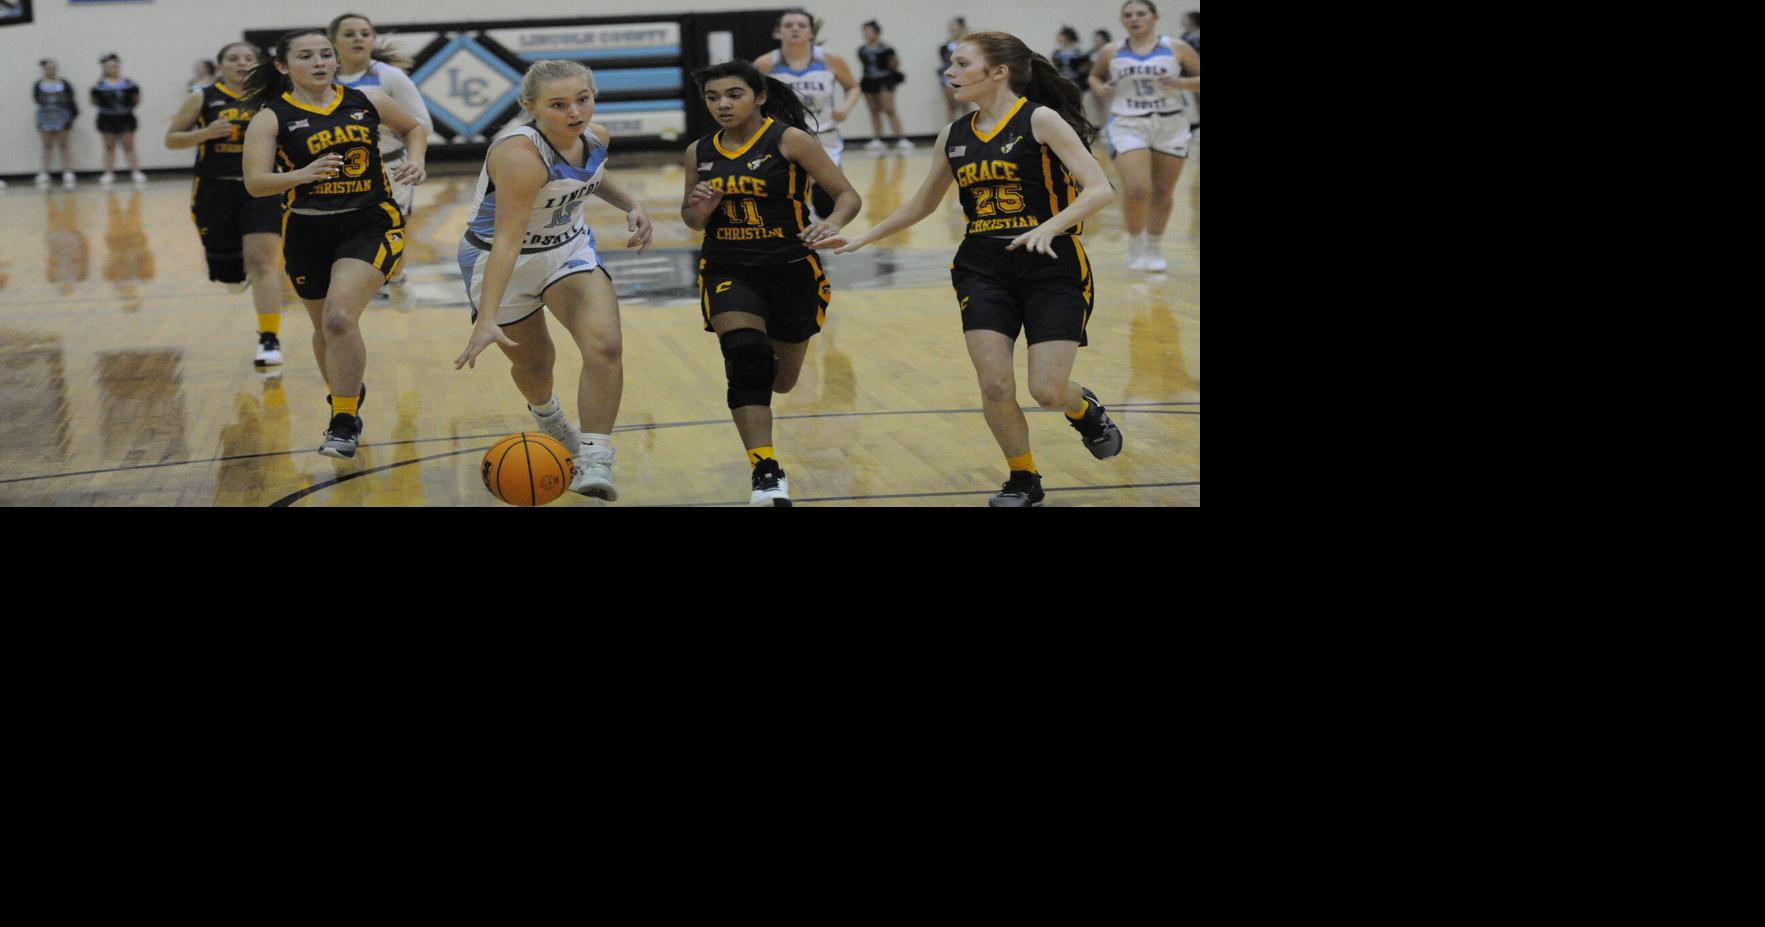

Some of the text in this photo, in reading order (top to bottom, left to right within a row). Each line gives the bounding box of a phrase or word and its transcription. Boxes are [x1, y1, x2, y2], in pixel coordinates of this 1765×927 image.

[306, 125, 372, 154] GRACE
[957, 159, 1022, 186] GRACE
[313, 179, 372, 195] HRISTIAN
[708, 175, 769, 198] RACE
[721, 197, 764, 227] 11
[970, 183, 1026, 216] 25
[716, 226, 784, 240] CHRISTIAN
[968, 214, 1039, 234] CHRISTIAN
